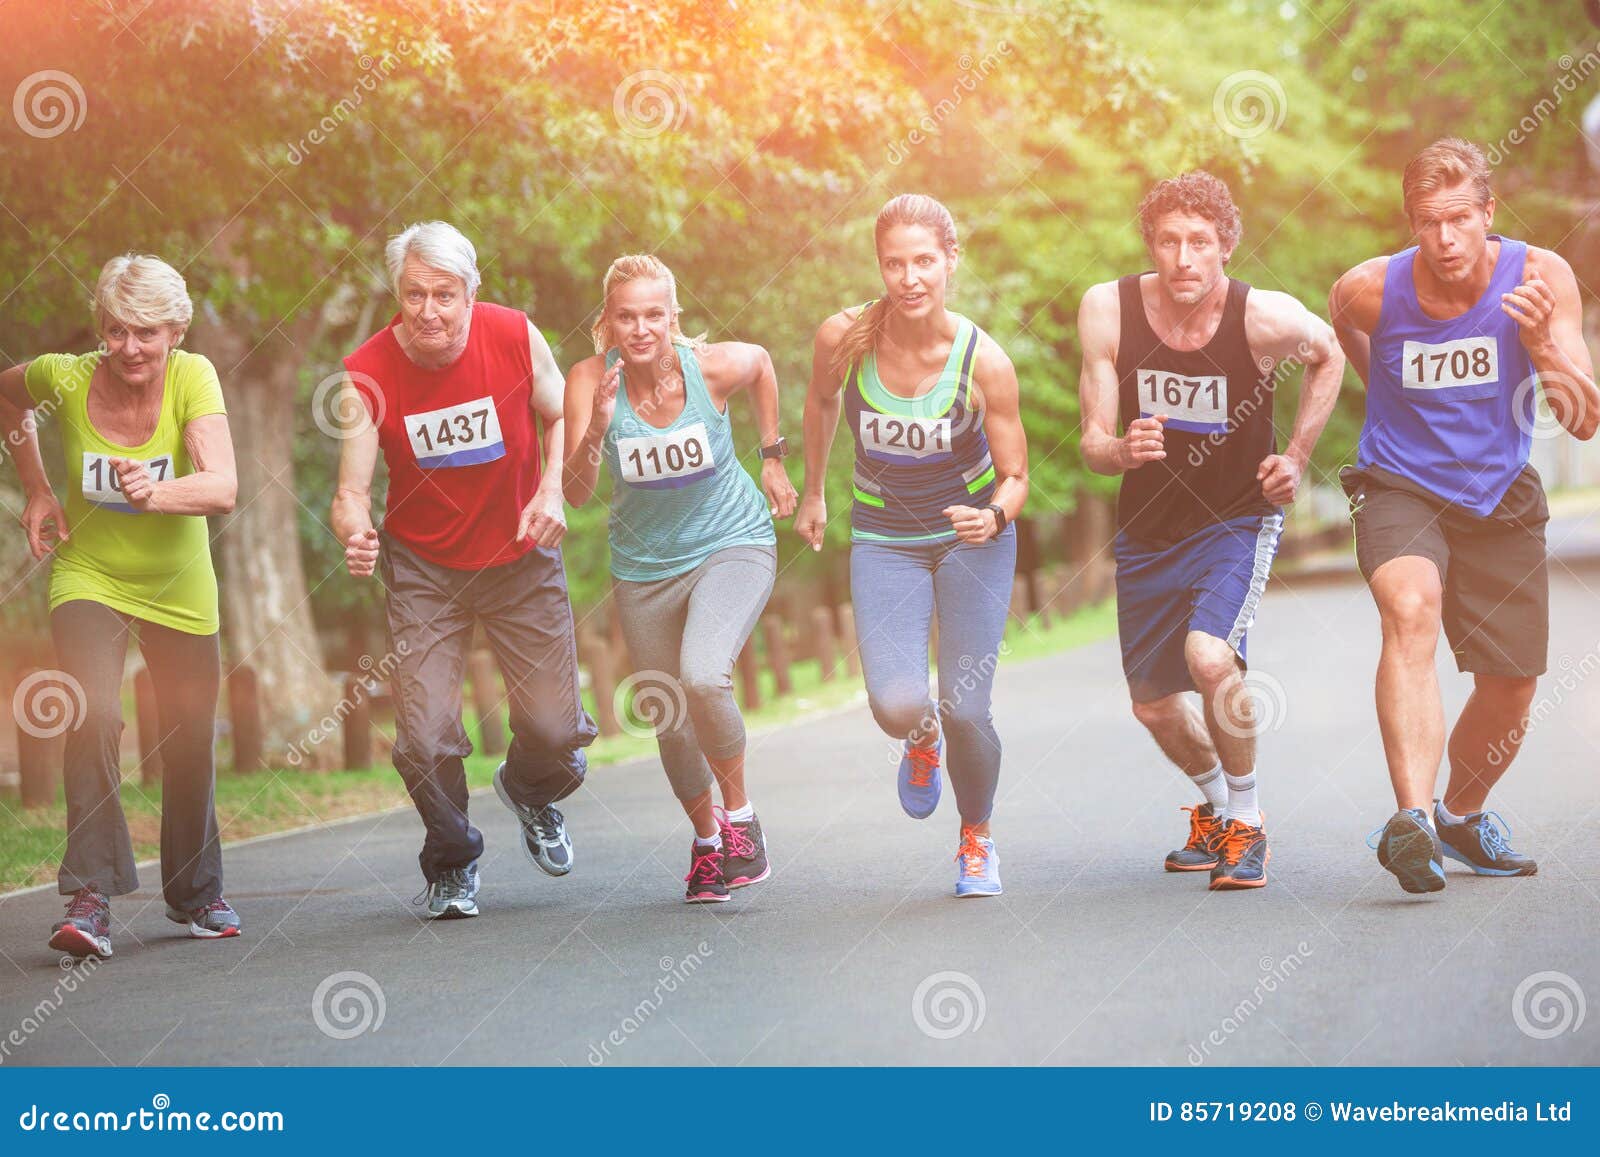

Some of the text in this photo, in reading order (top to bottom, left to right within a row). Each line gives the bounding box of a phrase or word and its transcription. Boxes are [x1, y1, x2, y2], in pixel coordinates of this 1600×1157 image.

[1411, 347, 1490, 382] 1708
[1144, 375, 1219, 410] 1671
[416, 409, 488, 451] 1437
[866, 418, 943, 451] 1201
[628, 437, 704, 477] 1109
[89, 458, 169, 492] 107
